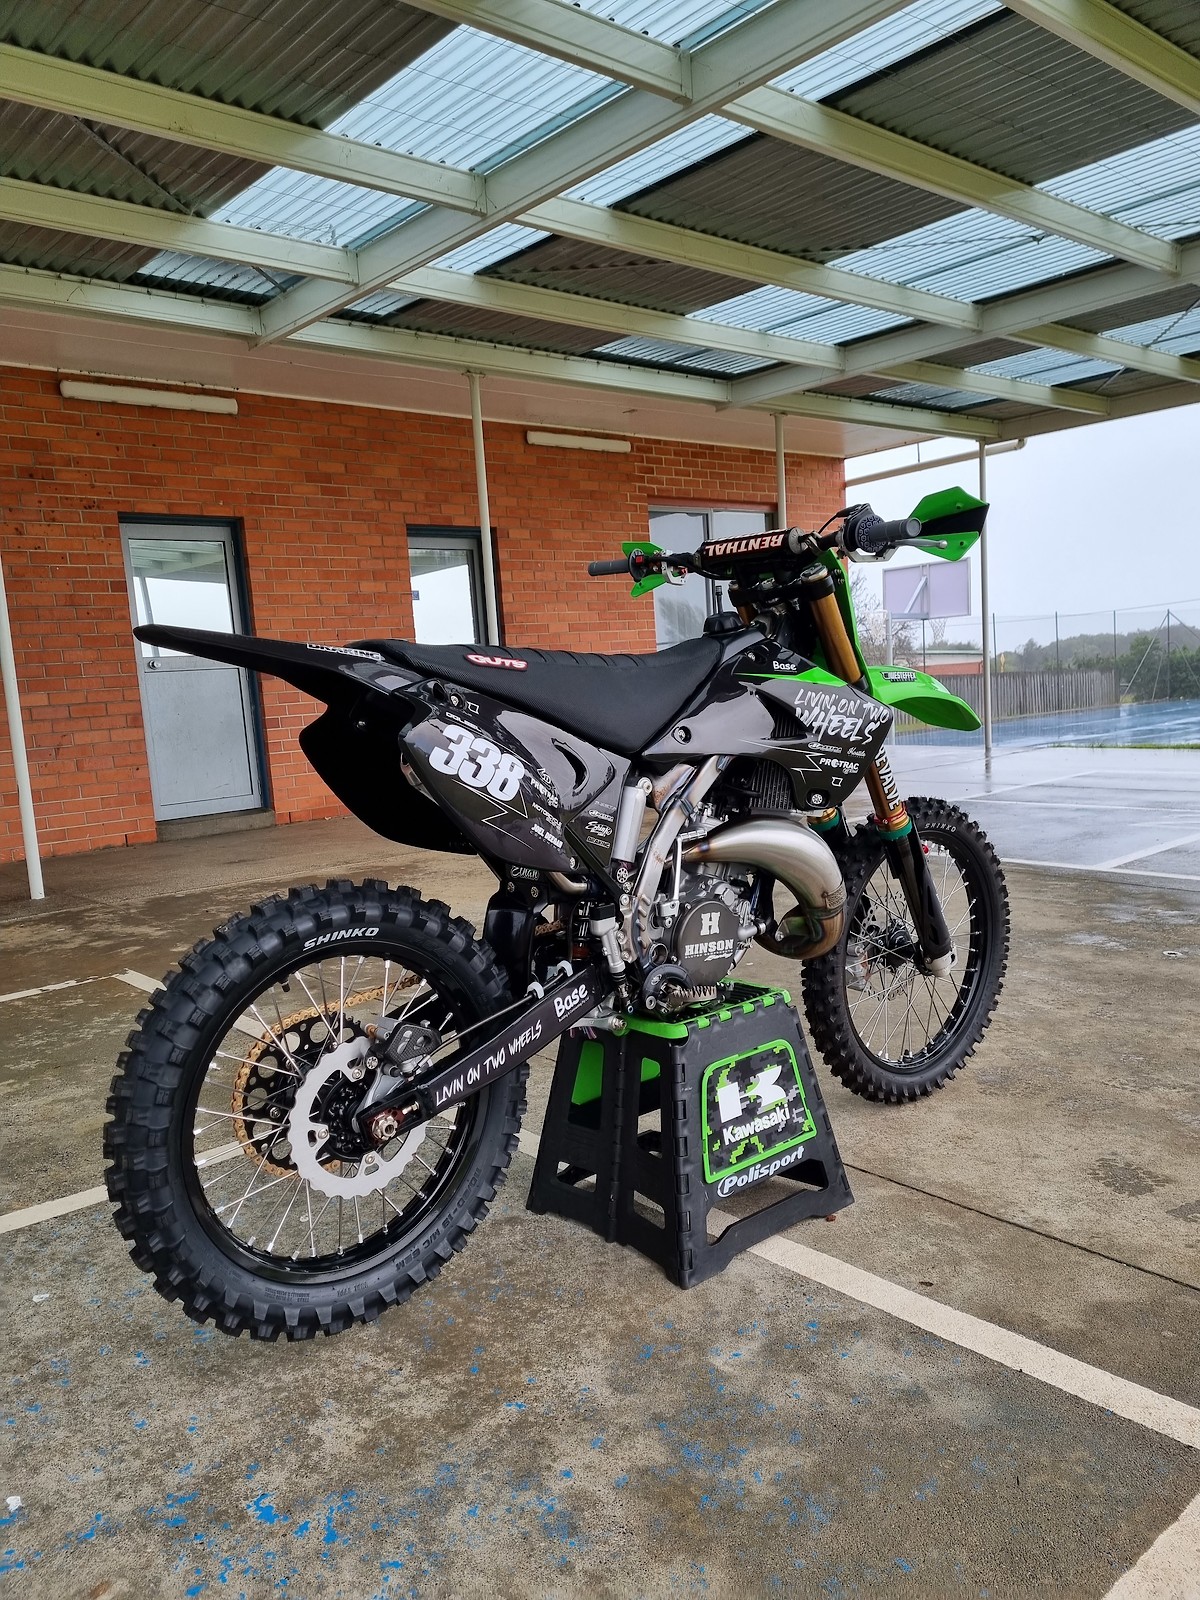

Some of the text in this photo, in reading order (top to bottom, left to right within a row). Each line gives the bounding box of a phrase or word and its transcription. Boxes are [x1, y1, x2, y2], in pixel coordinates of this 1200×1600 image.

[705, 534, 784, 557] RENTHAL
[467, 654, 528, 669] GUTS
[773, 660, 797, 671] Base
[837, 699, 861, 716] ON
[862, 702, 890, 724] TWO
[795, 705, 880, 745] WHEELS
[428, 724, 526, 802] 338
[924, 822, 957, 833] SHINKO
[700, 911, 721, 936] H
[302, 927, 380, 951] SHINKO
[685, 939, 734, 956] HINSON
[554, 984, 588, 1018] Base
[436, 1019, 542, 1106] LIVIN ON TWO WHEELS
[722, 1103, 791, 1146] Kawasaki
[718, 1145, 805, 1196] Polisport
